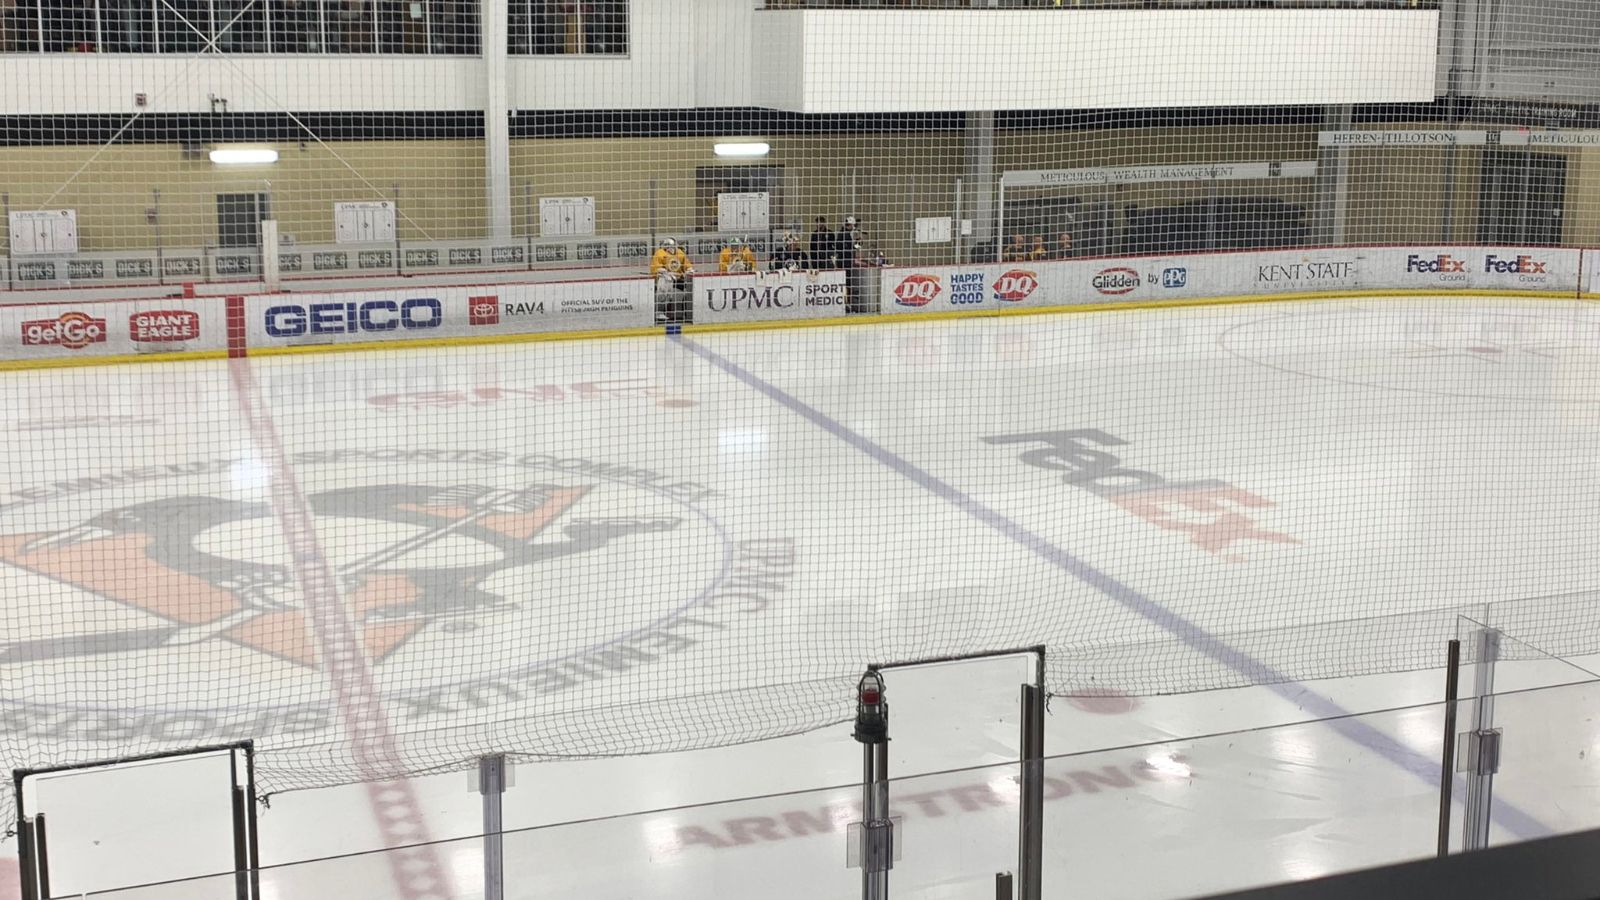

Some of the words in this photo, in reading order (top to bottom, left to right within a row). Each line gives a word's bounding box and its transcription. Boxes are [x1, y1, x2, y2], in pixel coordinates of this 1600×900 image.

[1040, 171, 1105, 182] METICULOUS
[1114, 169, 1157, 180] WEALTH
[1160, 166, 1234, 179] MANAGEMENT
[1258, 265, 1303, 282] KENT
[1306, 262, 1353, 280] STATE
[1407, 255, 1465, 273] FedEx
[1485, 255, 1546, 274] FedEx
[951, 273, 984, 283] HAPPY
[1000, 275, 1034, 295] DQ
[1092, 274, 1141, 289] Glidden
[1148, 272, 1160, 284] by
[1163, 269, 1186, 286] PPG
[901, 281, 935, 299] DQ
[951, 283, 984, 292] TASTES
[706, 285, 794, 311] UPMC
[951, 292, 984, 304] GOOD
[265, 298, 442, 337] GEICO
[505, 302, 545, 316] RAV4
[137, 314, 192, 327] GIANT
[28, 319, 100, 344] getGo
[138, 326, 192, 338] EAGLE
